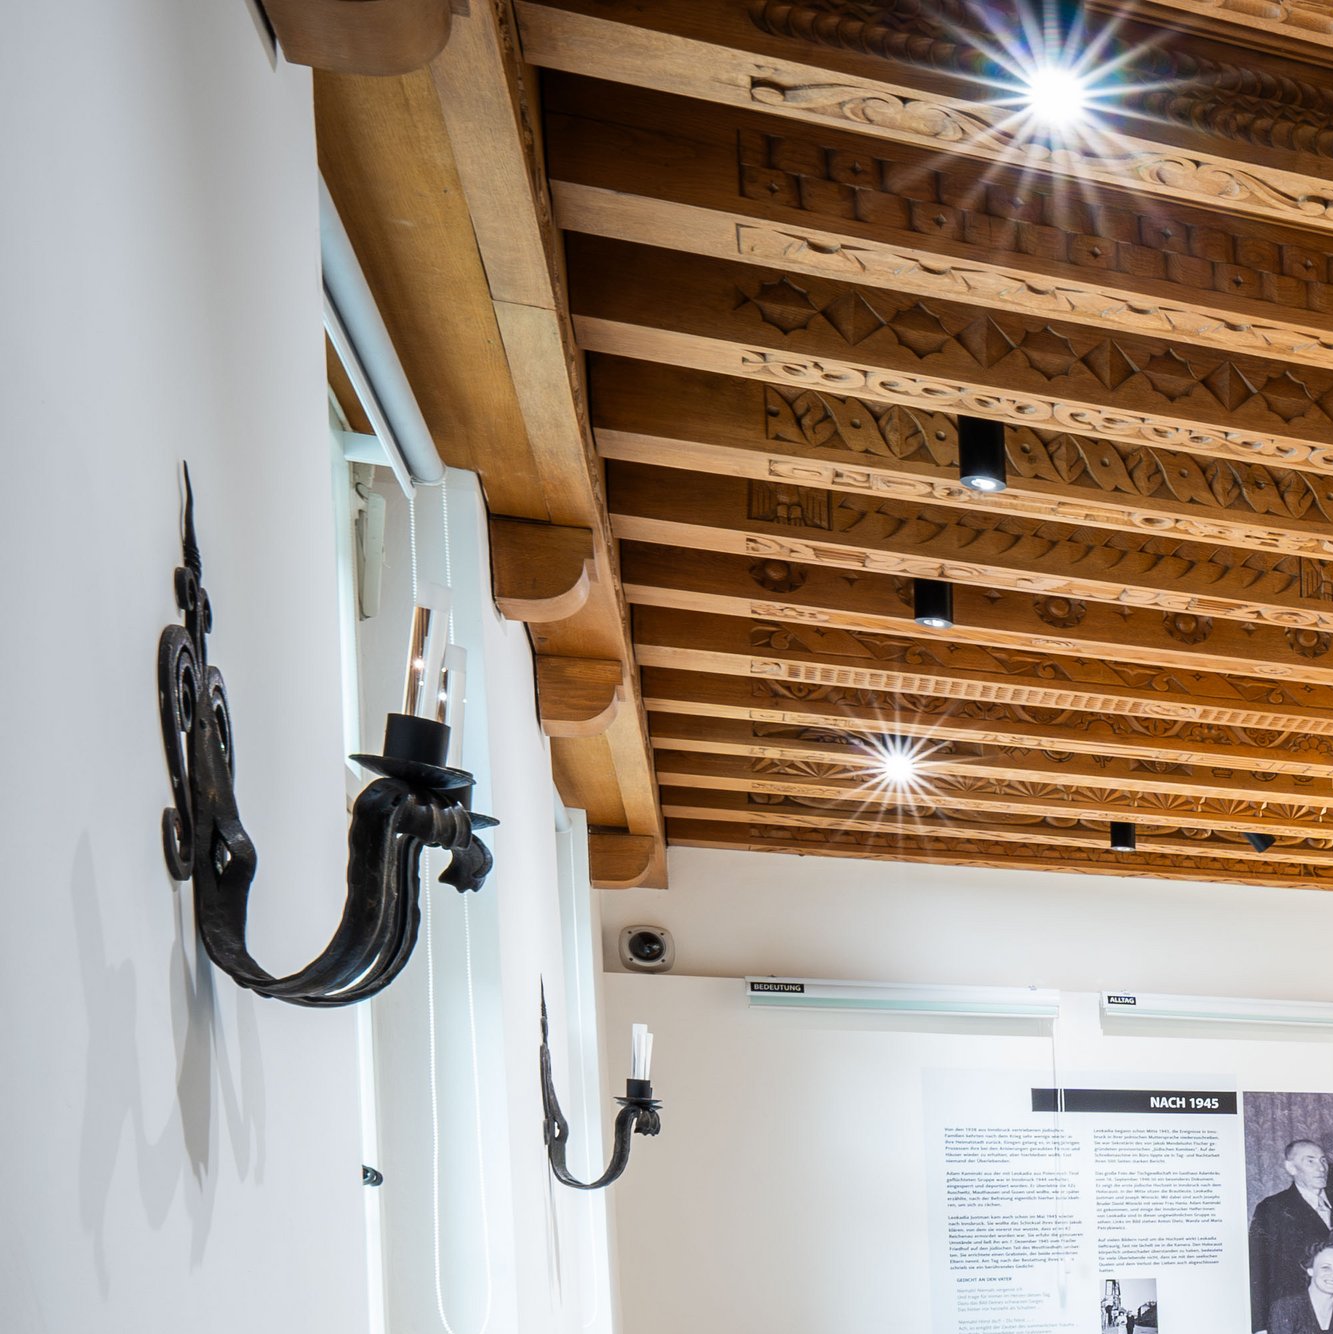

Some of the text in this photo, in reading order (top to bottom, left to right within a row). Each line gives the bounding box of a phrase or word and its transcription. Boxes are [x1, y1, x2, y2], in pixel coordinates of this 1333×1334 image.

[1110, 996, 1135, 1004] ALLTAG
[1150, 1096, 1219, 1109] NACH 1945
